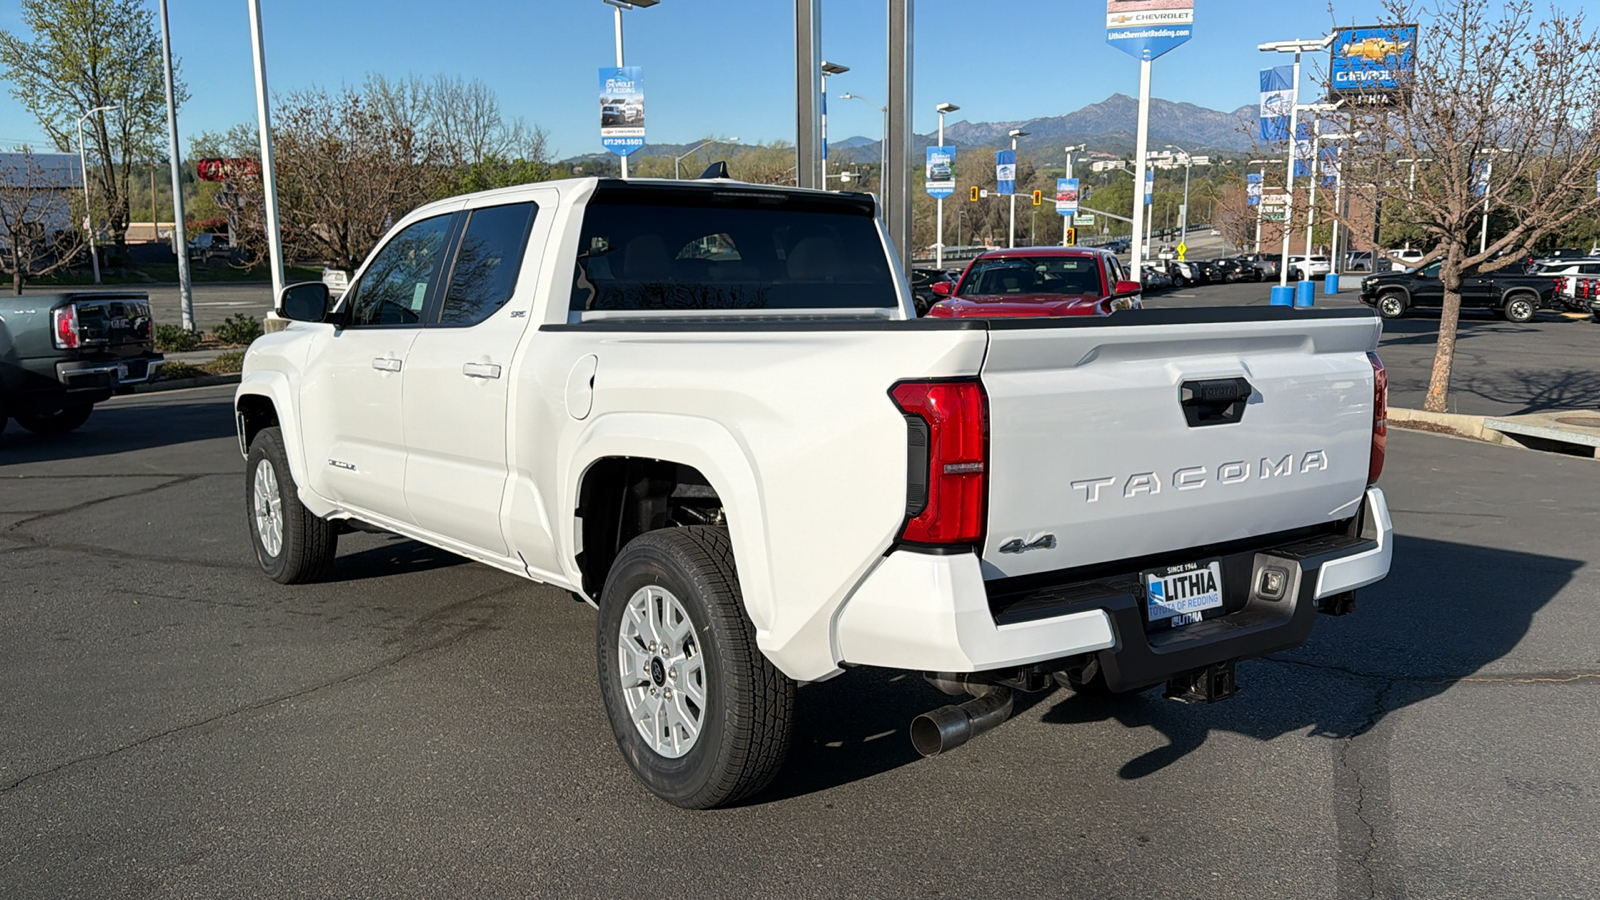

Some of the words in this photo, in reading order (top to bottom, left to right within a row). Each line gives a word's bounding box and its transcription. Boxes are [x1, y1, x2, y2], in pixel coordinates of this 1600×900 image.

[1135, 12, 1190, 21] CHEVROLET
[1108, 29, 1190, 40] LithiaChevroletRedding.com
[1336, 70, 1408, 81] CHEVROL
[1353, 94, 1389, 104] IHIA
[1203, 386, 1236, 397] TOYOTA
[1070, 449, 1329, 503] TACOMA
[1167, 565, 1184, 575] SINCE
[1163, 571, 1218, 602] LITHIA
[1149, 604, 1175, 616] TOYOTA
[1176, 601, 1185, 611] OF
[1187, 593, 1219, 607] REDDING
[1178, 611, 1203, 625] LITHIA
